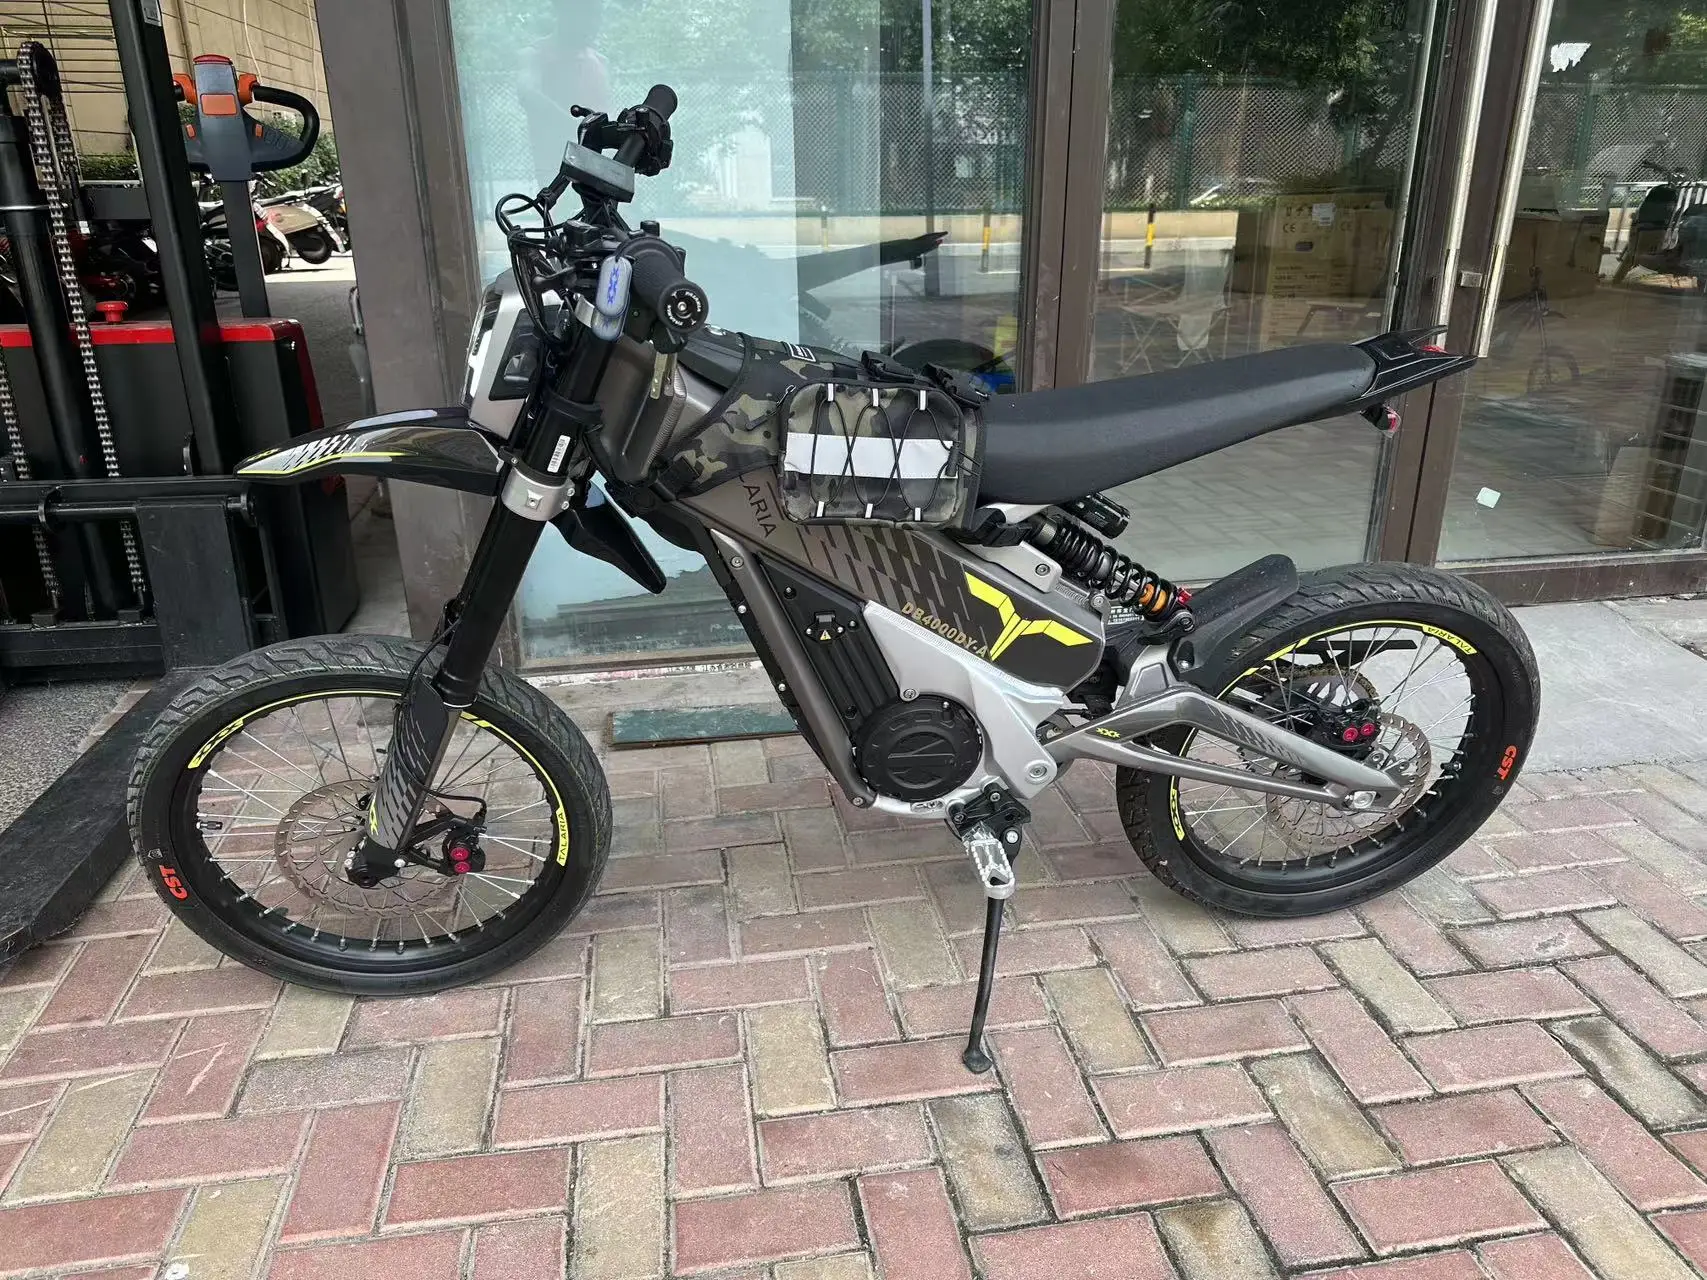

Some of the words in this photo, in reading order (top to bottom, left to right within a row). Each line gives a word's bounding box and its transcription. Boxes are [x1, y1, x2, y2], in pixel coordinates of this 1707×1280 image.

[901, 602, 989, 658] DB4000DY-A
[1427, 626, 1472, 653] TALARIA
[1497, 745, 1517, 780] CST
[558, 812, 567, 860] TALARIA
[159, 865, 188, 899] CST
